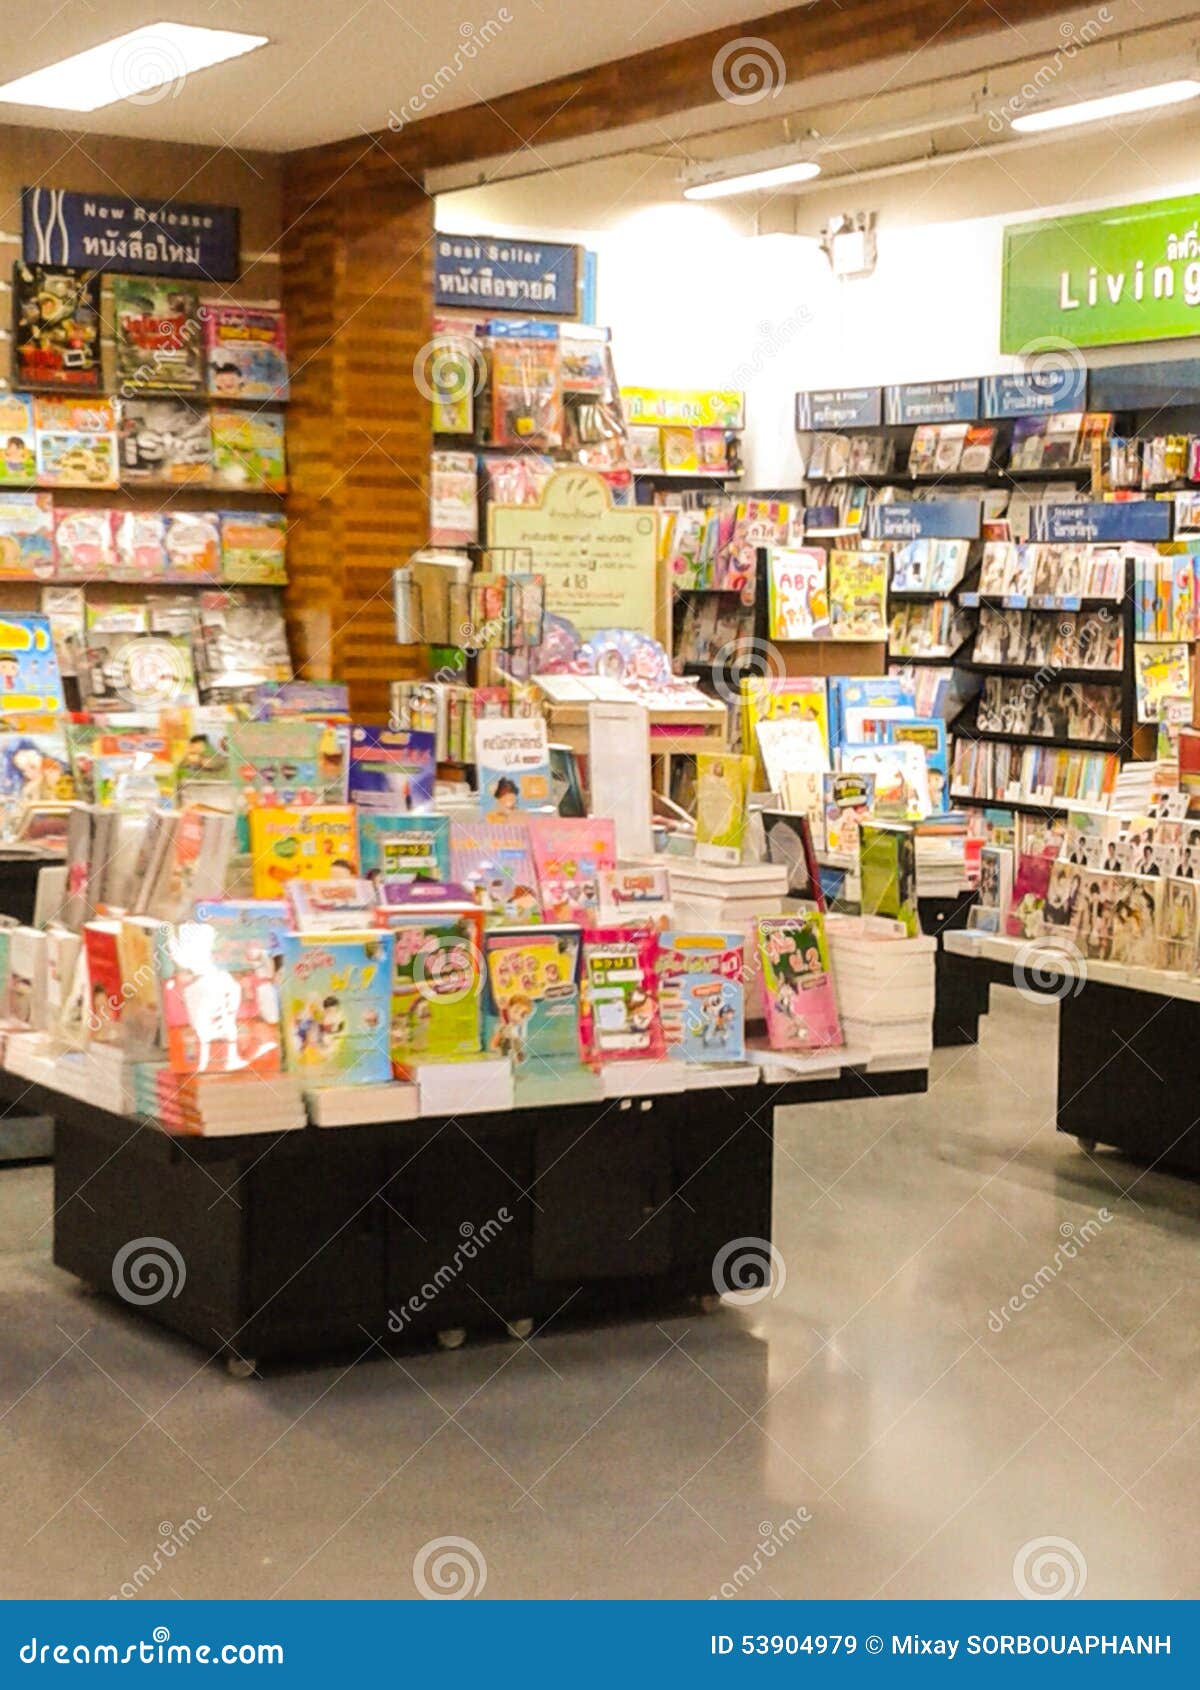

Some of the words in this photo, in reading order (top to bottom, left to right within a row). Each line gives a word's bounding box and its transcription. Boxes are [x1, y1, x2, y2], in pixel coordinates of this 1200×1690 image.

[84, 202, 124, 220] New
[134, 207, 213, 228] Release
[83, 229, 200, 263] หนังสือใหม่
[439, 241, 481, 259] Best
[488, 246, 542, 264] Seller
[439, 267, 557, 301] หนังสือขายดี
[1060, 260, 1200, 310] Living
